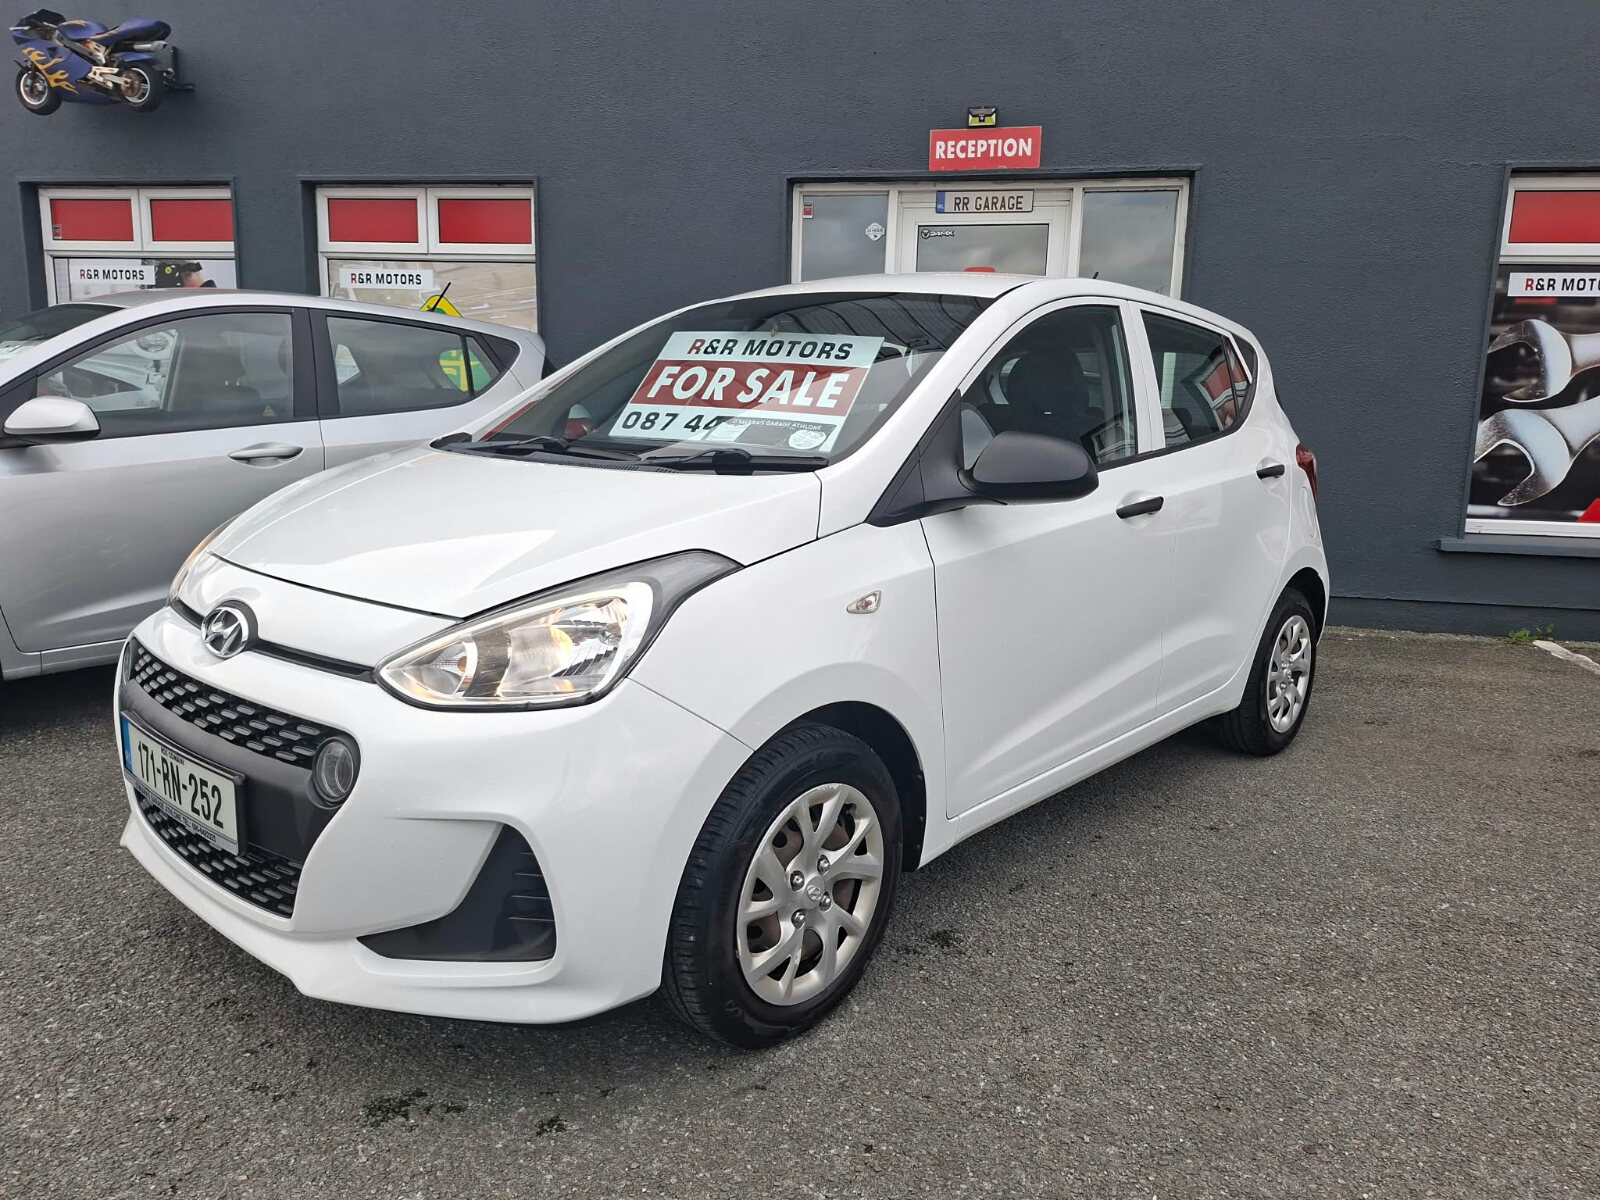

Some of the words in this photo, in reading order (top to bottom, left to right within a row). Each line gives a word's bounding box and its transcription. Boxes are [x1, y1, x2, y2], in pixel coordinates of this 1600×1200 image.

[935, 138, 1032, 159] RECEPTION
[954, 196, 970, 211] RR
[974, 195, 1024, 211] GARAGE
[80, 268, 100, 280] R&R
[102, 269, 145, 280] MOTORS
[350, 273, 372, 284] R&R
[375, 273, 422, 285] MOTORS
[1524, 278, 1557, 291] R&R
[1561, 278, 1600, 291] MOT
[687, 338, 738, 356] R&R
[741, 339, 853, 360] MOTORS
[647, 366, 736, 401] FOR
[736, 368, 850, 409] SALE
[621, 411, 679, 432] 087
[138, 740, 224, 830] 171-RN-252
